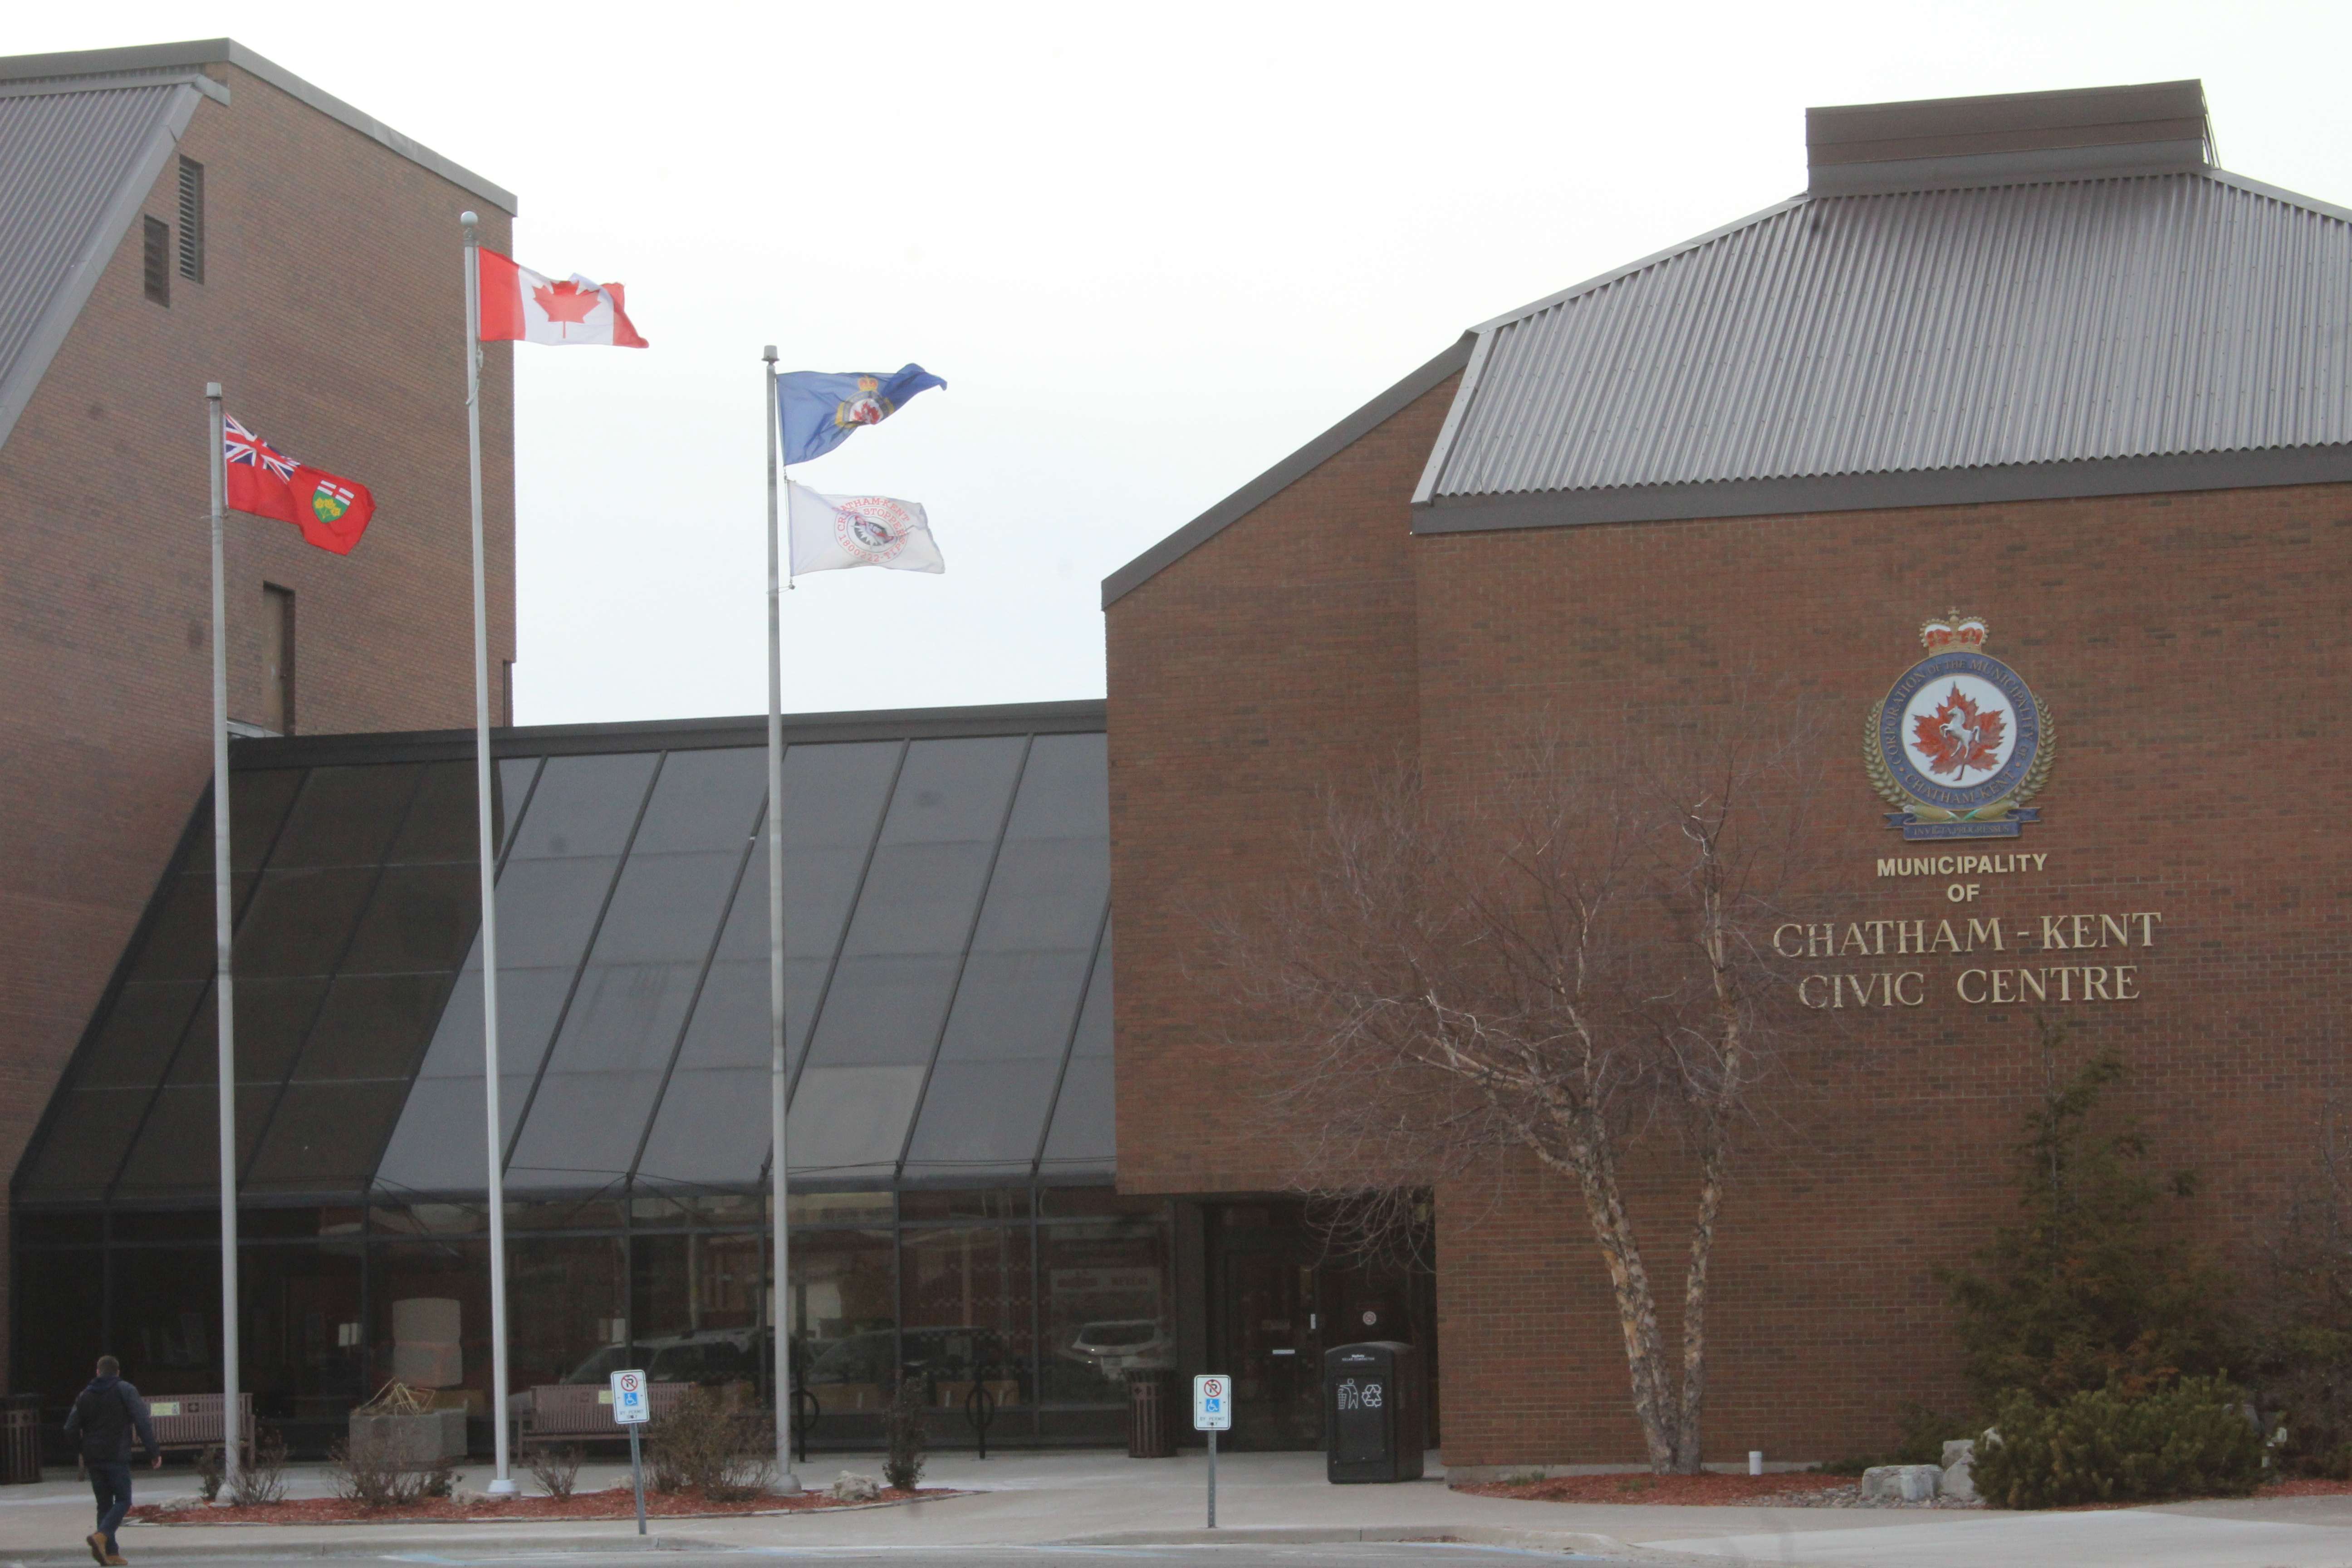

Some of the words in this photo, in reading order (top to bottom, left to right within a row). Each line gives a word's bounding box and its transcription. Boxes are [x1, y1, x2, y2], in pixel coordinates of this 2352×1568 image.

[831, 496, 910, 521] ATHAM-KENT
[1886, 670, 1926, 765] CORPORATION
[1928, 664, 1940, 674] OF
[1945, 660, 1966, 670] THE
[1970, 659, 2034, 741] MUNICIPALITY
[1905, 771, 2015, 804] CHATHAM-KENT
[1877, 853, 2048, 877] MUNICIPALITY
[1947, 884, 1980, 902] OF
[1798, 971, 1924, 1009] CIVIC
[1957, 965, 2140, 1003] CENTRE
